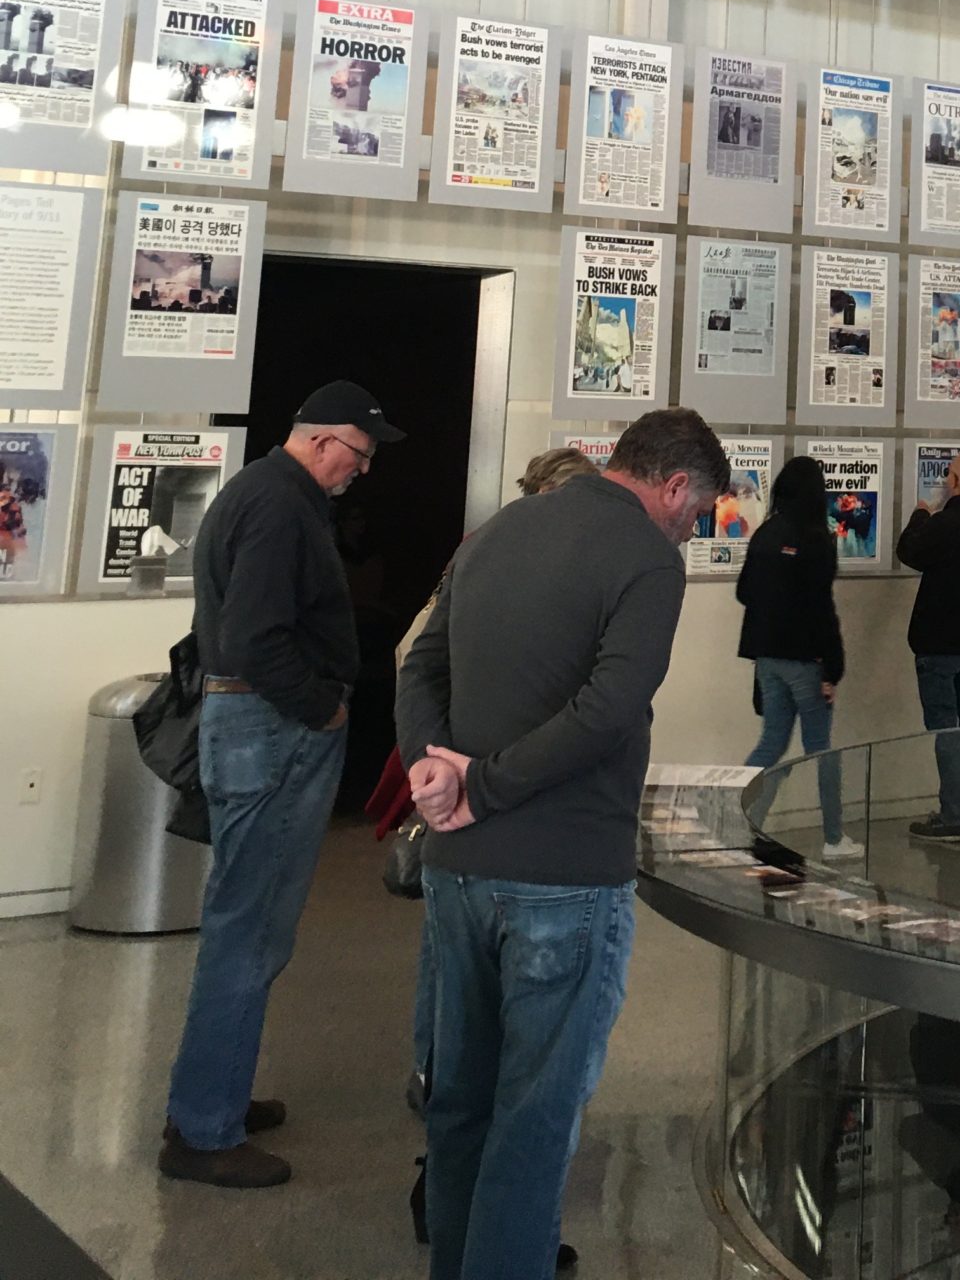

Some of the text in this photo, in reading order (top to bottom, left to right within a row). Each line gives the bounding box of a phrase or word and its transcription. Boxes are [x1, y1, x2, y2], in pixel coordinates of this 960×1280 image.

[338, 2, 394, 24] EXTRA
[166, 10, 256, 38] ATTACKED
[319, 36, 406, 66] HORROR
[460, 33, 544, 55] Bush vows terrorist
[460, 48, 541, 68] acts to be avenged
[592, 56, 667, 76] TERRORISTS ATTACK
[711, 56, 752, 77] ИЗВЕСТИЯ
[590, 66, 668, 86] NEW YORK, PENTAGON
[857, 78, 880, 91] Tribune
[710, 86, 782, 107] Армагеддон
[839, 90, 860, 103] nation
[138, 217, 242, 240] 美國이 공격 당했다
[608, 245, 652, 257] Moines Register
[587, 265, 648, 284] BUSH VOWS
[576, 279, 658, 299] TO STRIKE BACK
[147, 435, 197, 444] SPECIAL EDITION
[737, 444, 770, 454] MONITOR
[836, 445, 862, 454] Mountain
[134, 445, 207, 458] NEW POST
[735, 458, 769, 469] terror
[840, 461, 878, 477] nation
[117, 466, 152, 487] ACT
[845, 476, 871, 492] evil'
[121, 487, 143, 507] OF
[111, 508, 150, 529] WAR
[118, 538, 137, 547] Trade
